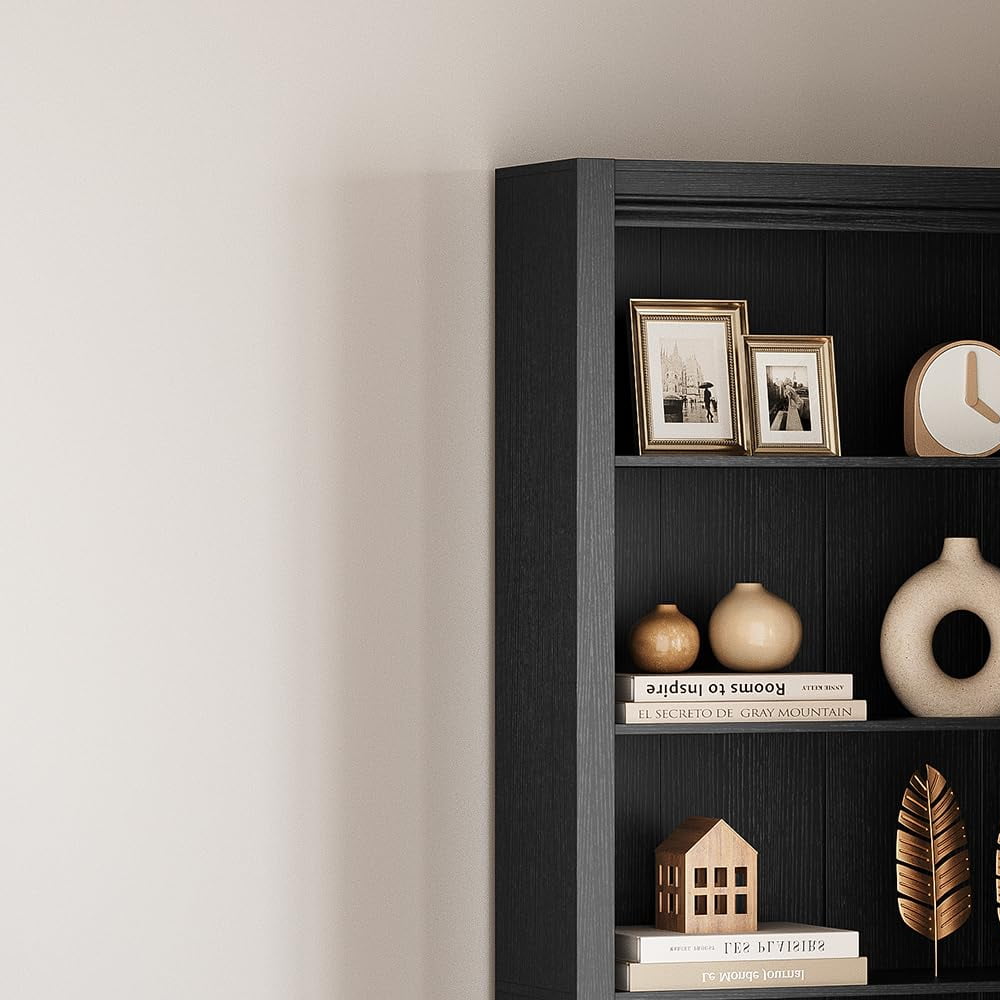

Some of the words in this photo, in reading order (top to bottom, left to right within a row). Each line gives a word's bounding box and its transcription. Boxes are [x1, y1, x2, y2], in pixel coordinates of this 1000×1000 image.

[646, 680, 703, 697] Inspire
[708, 683, 725, 694] to
[731, 682, 786, 695] Rooms
[638, 709, 652, 719] EL
[655, 708, 712, 719] SECRETO
[716, 708, 733, 718] DE
[740, 708, 774, 718] GRAY
[778, 707, 852, 718] MOUNTAIN
